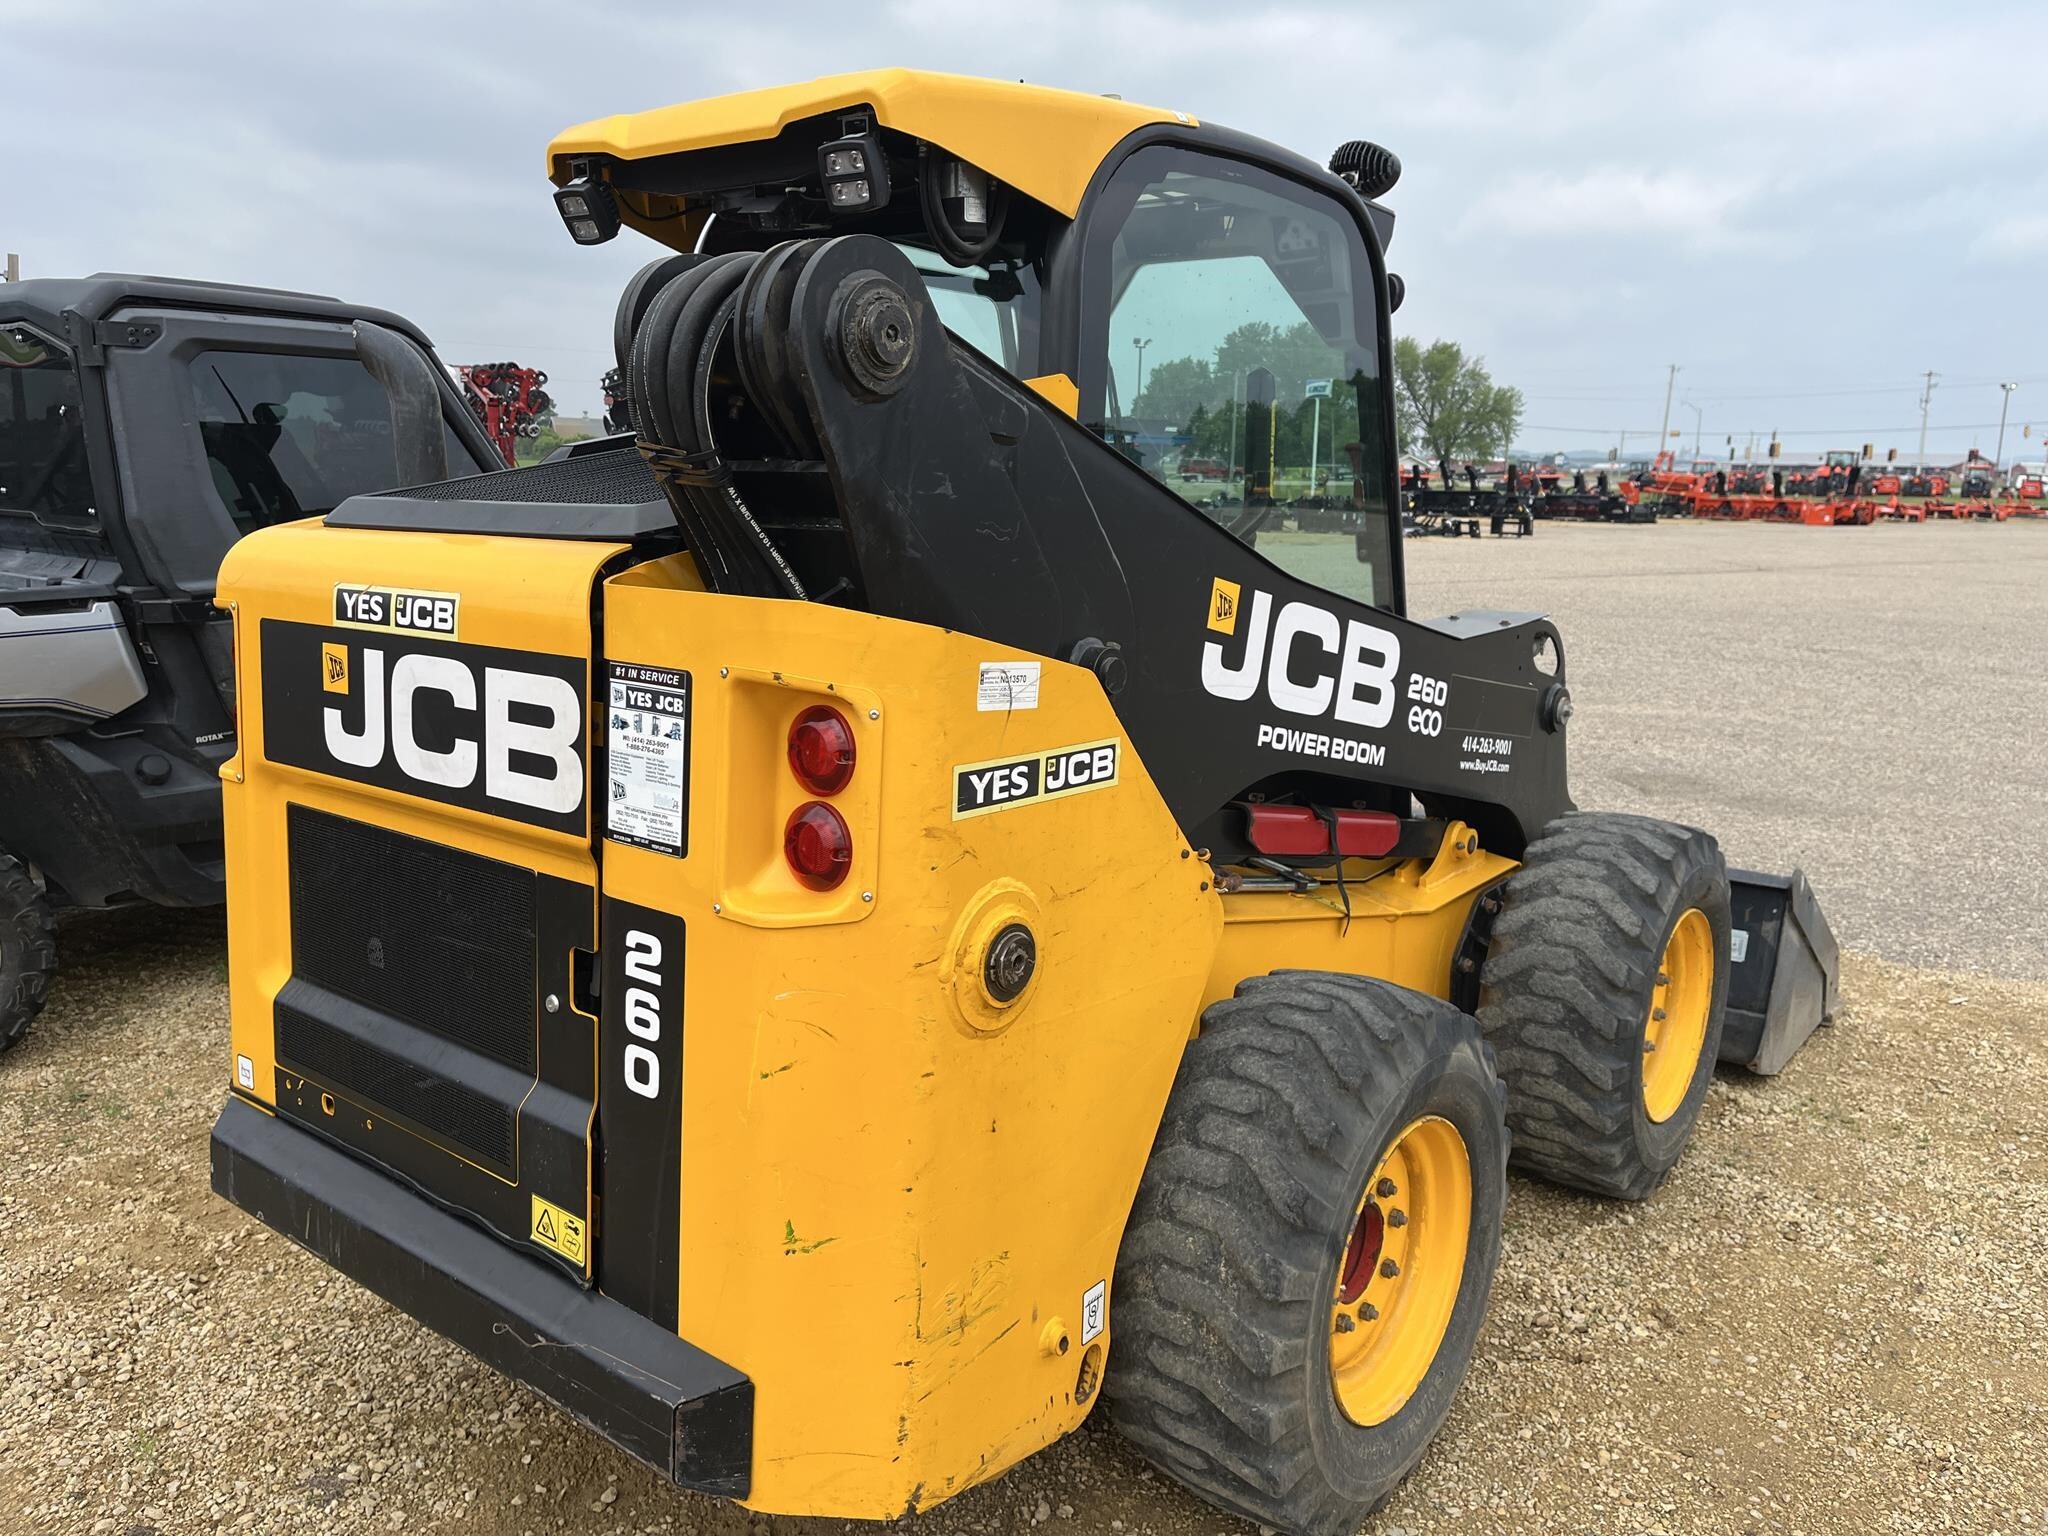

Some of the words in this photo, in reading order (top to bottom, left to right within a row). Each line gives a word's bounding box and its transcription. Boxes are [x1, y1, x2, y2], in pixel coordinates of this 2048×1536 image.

[727, 486, 738, 499] 1W
[750, 519, 761, 533] mm
[343, 592, 383, 621] YES
[396, 597, 453, 630] JCB
[1217, 592, 1232, 618] JCB
[328, 656, 344, 680] JCB
[1201, 589, 1400, 728] JCB
[615, 666, 626, 677] #1
[628, 668, 638, 679] IN
[640, 670, 680, 685] SERVICE
[628, 690, 653, 708] YES
[655, 695, 684, 713] JCB
[1408, 673, 1448, 707] 260
[323, 648, 583, 813] JCB
[1408, 705, 1442, 737] eco
[195, 732, 224, 744] ROTAX
[1462, 736, 1512, 755] 414-263-9001
[969, 765, 1029, 804] YES
[1046, 748, 1114, 790] JCB
[1460, 758, 1510, 774] www.BuyJCB.com
[624, 929, 662, 1100] 260
